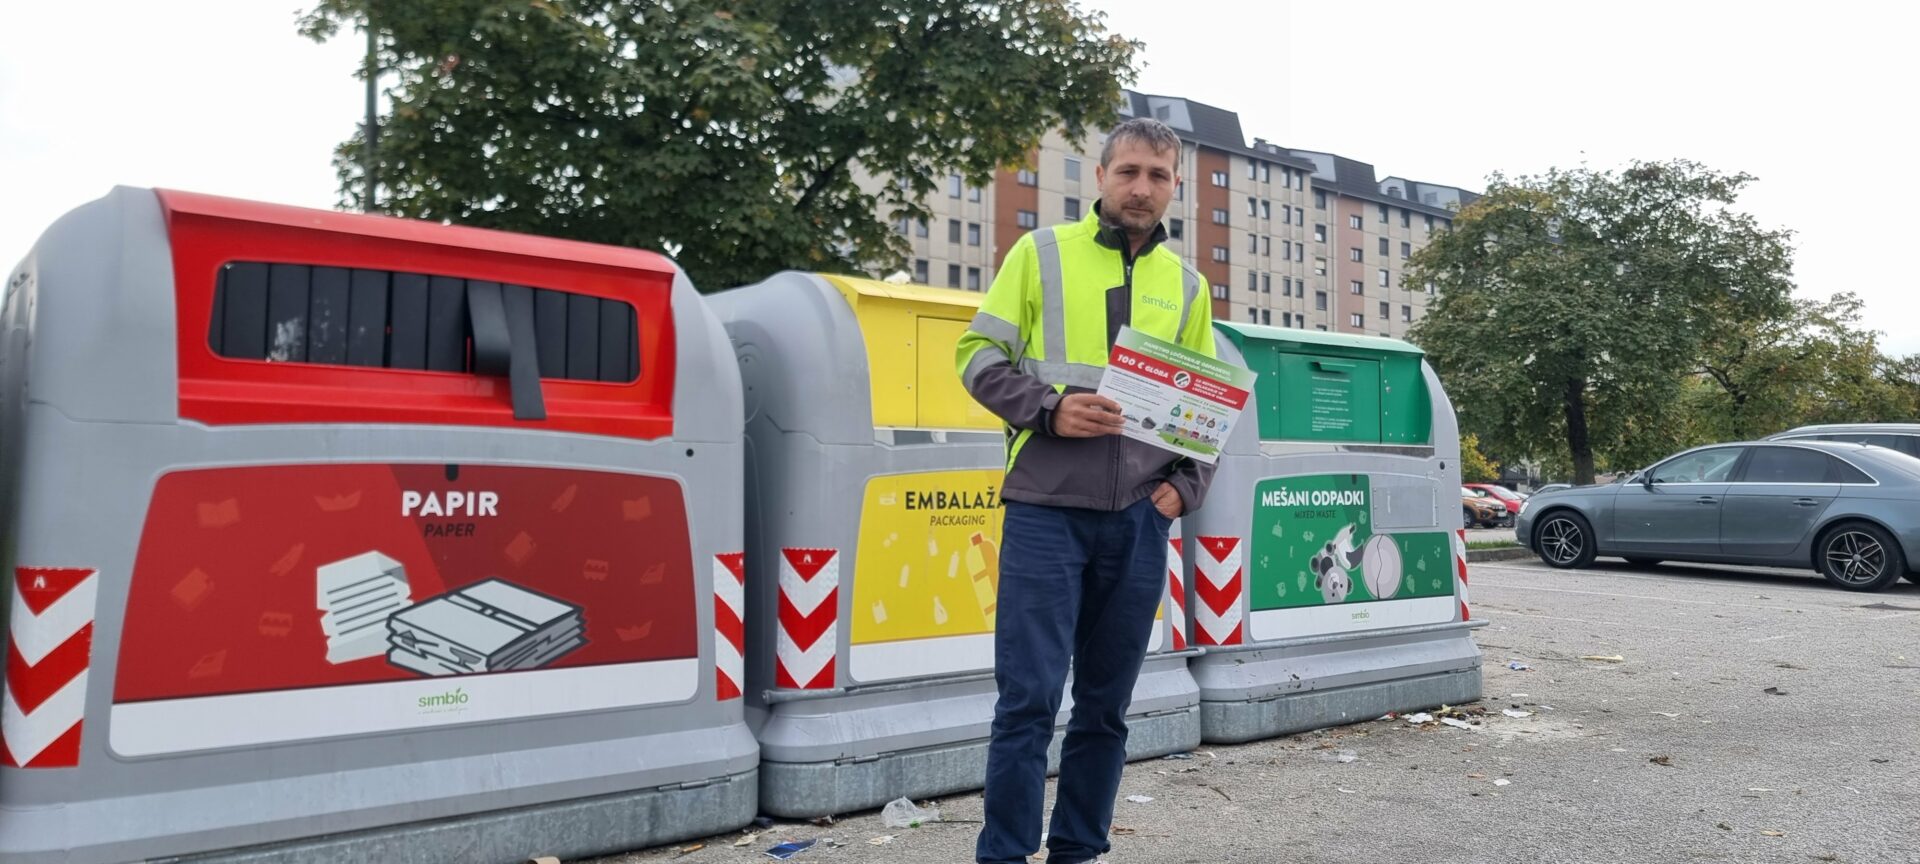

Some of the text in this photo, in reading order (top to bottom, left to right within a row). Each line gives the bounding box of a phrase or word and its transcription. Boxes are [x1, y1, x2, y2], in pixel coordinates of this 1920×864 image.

[1142, 295, 1177, 311] simbio
[1117, 354, 1169, 378] 100 € GLOBA
[402, 490, 499, 517] PAPIR
[1262, 486, 1364, 507] MEŠANI ODPADKI
[929, 514, 986, 526] PACKAGING
[1294, 510, 1336, 519] MIXED WASTE
[424, 522, 476, 538] PAPER
[418, 687, 469, 708] simbio
